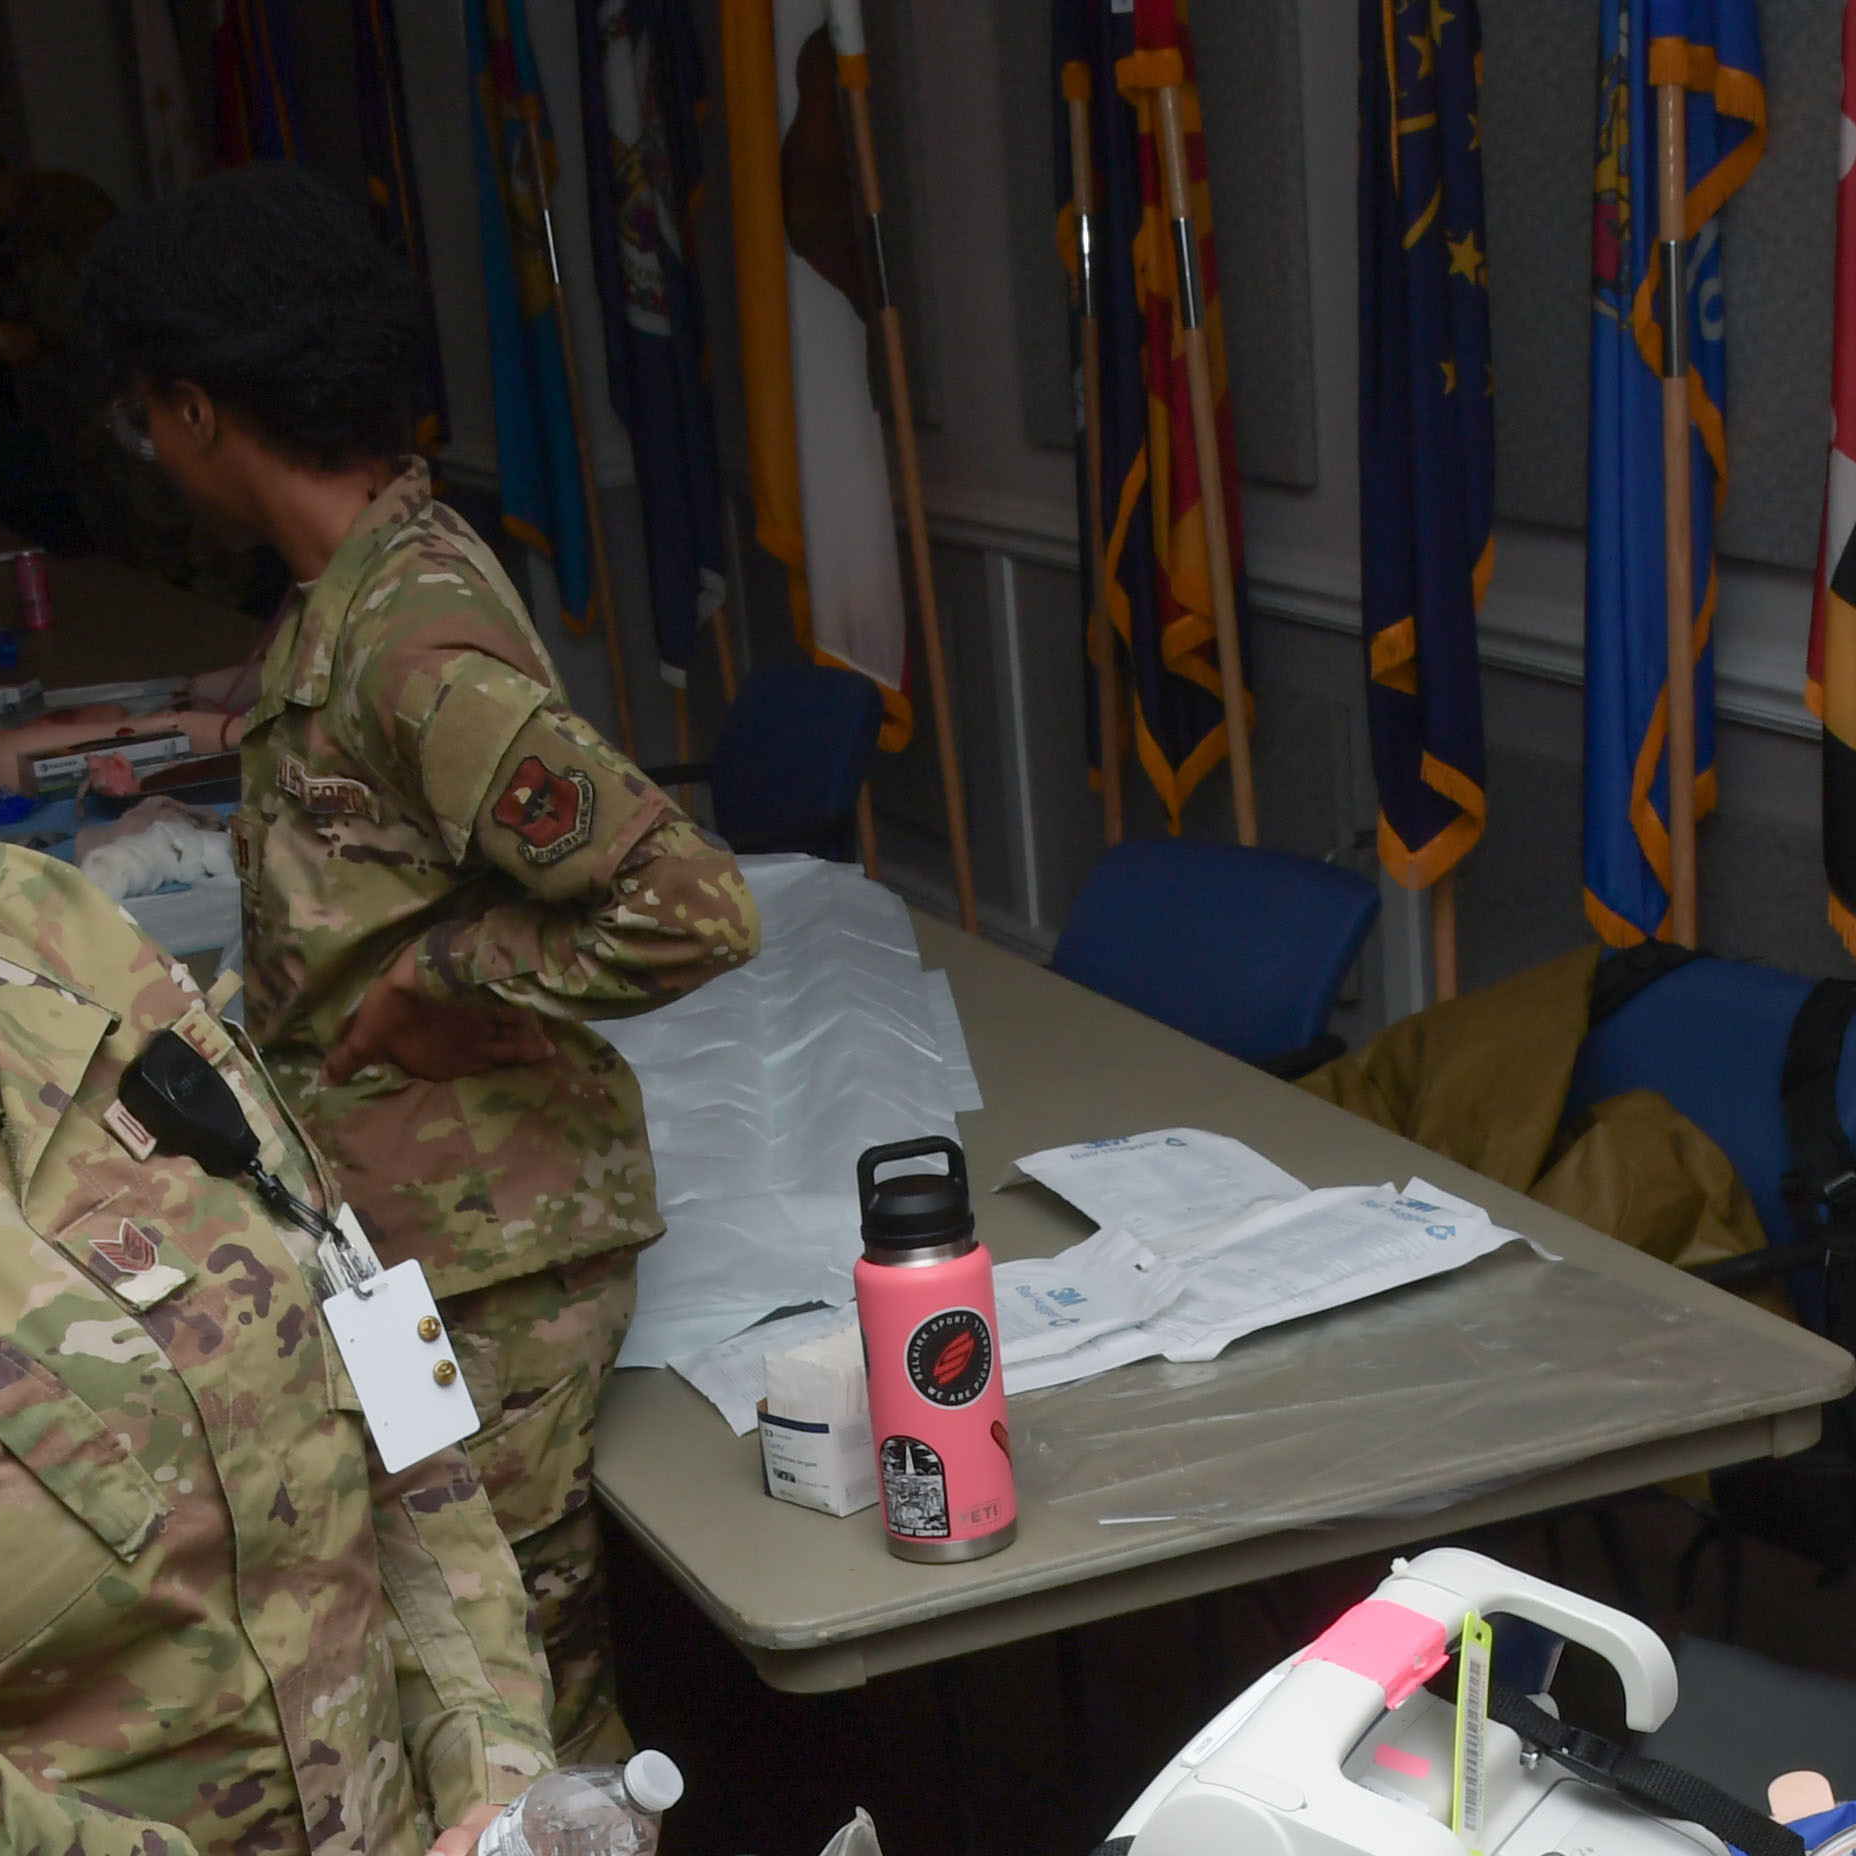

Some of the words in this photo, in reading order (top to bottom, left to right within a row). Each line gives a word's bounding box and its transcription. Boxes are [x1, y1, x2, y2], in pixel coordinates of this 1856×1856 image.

[911, 1332, 929, 1381] SELKIRK
[931, 1314, 968, 1332] SPORT
[927, 1385, 943, 1400] WE
[948, 1389, 972, 1402] ARE
[959, 1505, 999, 1524] YETI
